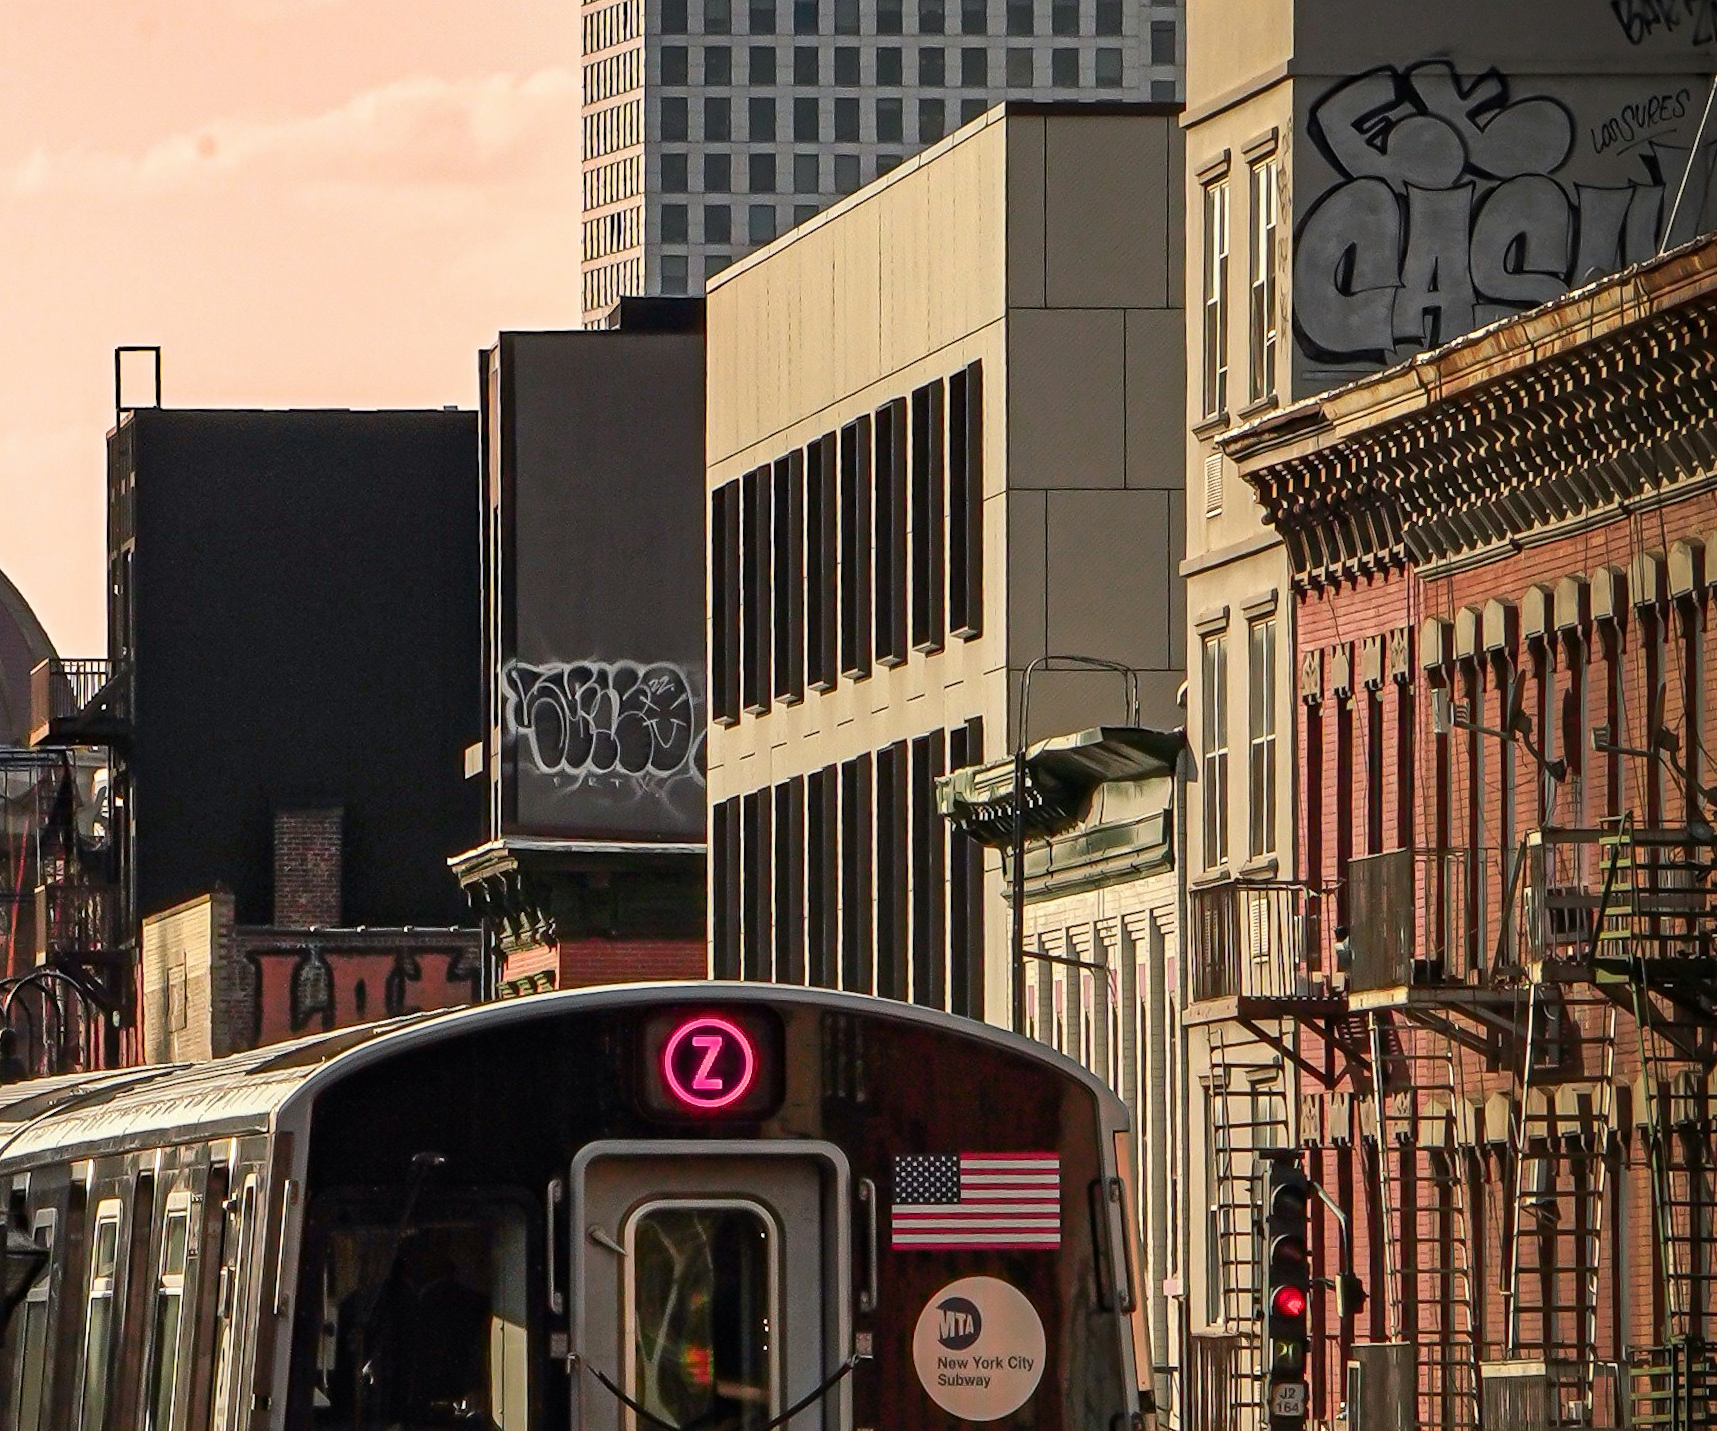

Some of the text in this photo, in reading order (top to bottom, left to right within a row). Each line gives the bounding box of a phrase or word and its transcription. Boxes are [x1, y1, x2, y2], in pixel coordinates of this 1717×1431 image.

[692, 1034, 723, 1091] Z
[937, 1309, 975, 1340] MTA
[938, 1356, 1034, 1371] New York City
[938, 1373, 991, 1388] Subway
[1279, 1387, 1296, 1399] J2
[1277, 1403, 1299, 1413] 164
